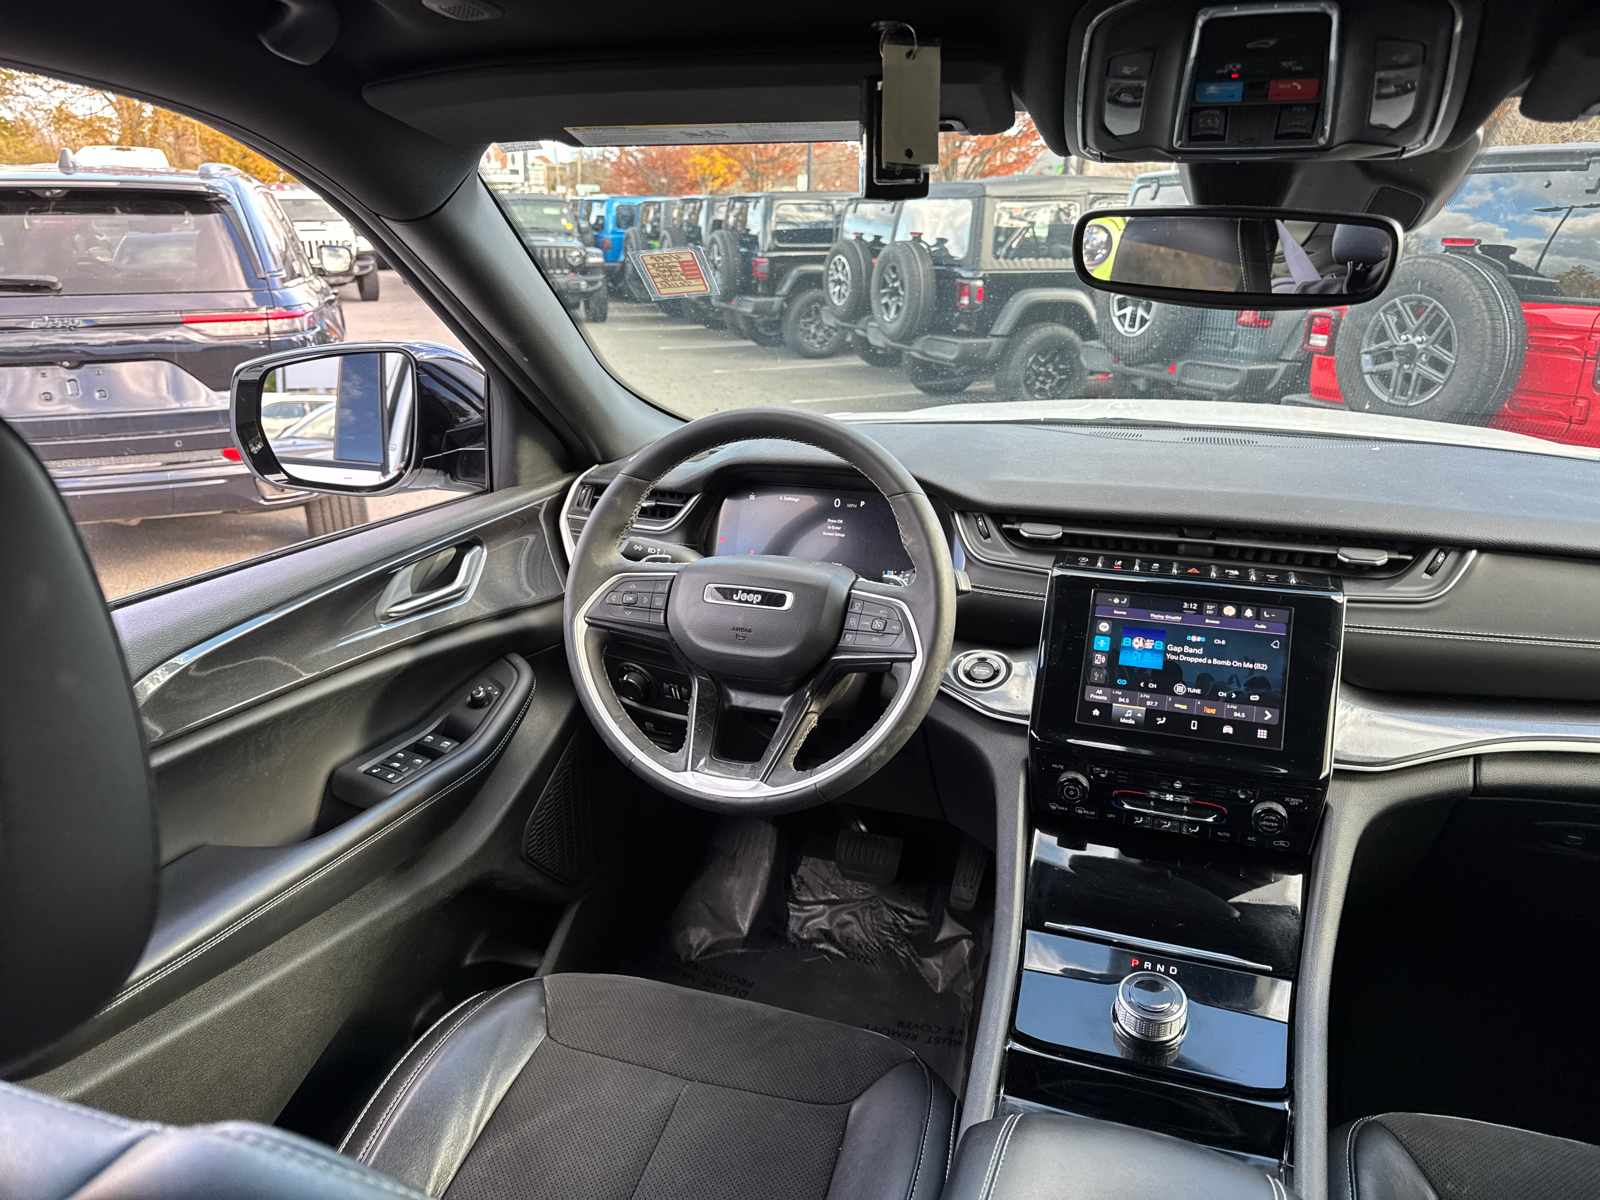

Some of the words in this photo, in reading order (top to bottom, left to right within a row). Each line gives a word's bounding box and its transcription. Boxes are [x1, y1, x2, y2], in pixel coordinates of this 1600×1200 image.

[834, 498, 841, 508] 0
[732, 590, 762, 604] Jeep
[1182, 602, 1198, 610] 3:12
[1166, 644, 1183, 653] Gap
[1183, 645, 1203, 654] Band
[1179, 654, 1207, 664] Dropped
[1212, 658, 1231, 666] Bomb
[1253, 662, 1268, 671] (82)
[1130, 958, 1140, 967] P
[1144, 961, 1152, 970] R
[1156, 964, 1165, 973] N
[1169, 966, 1178, 975] D
[703, 979, 748, 999] DEALER
[896, 1020, 941, 1034] COVER
[925, 1036, 962, 1047] MUST
